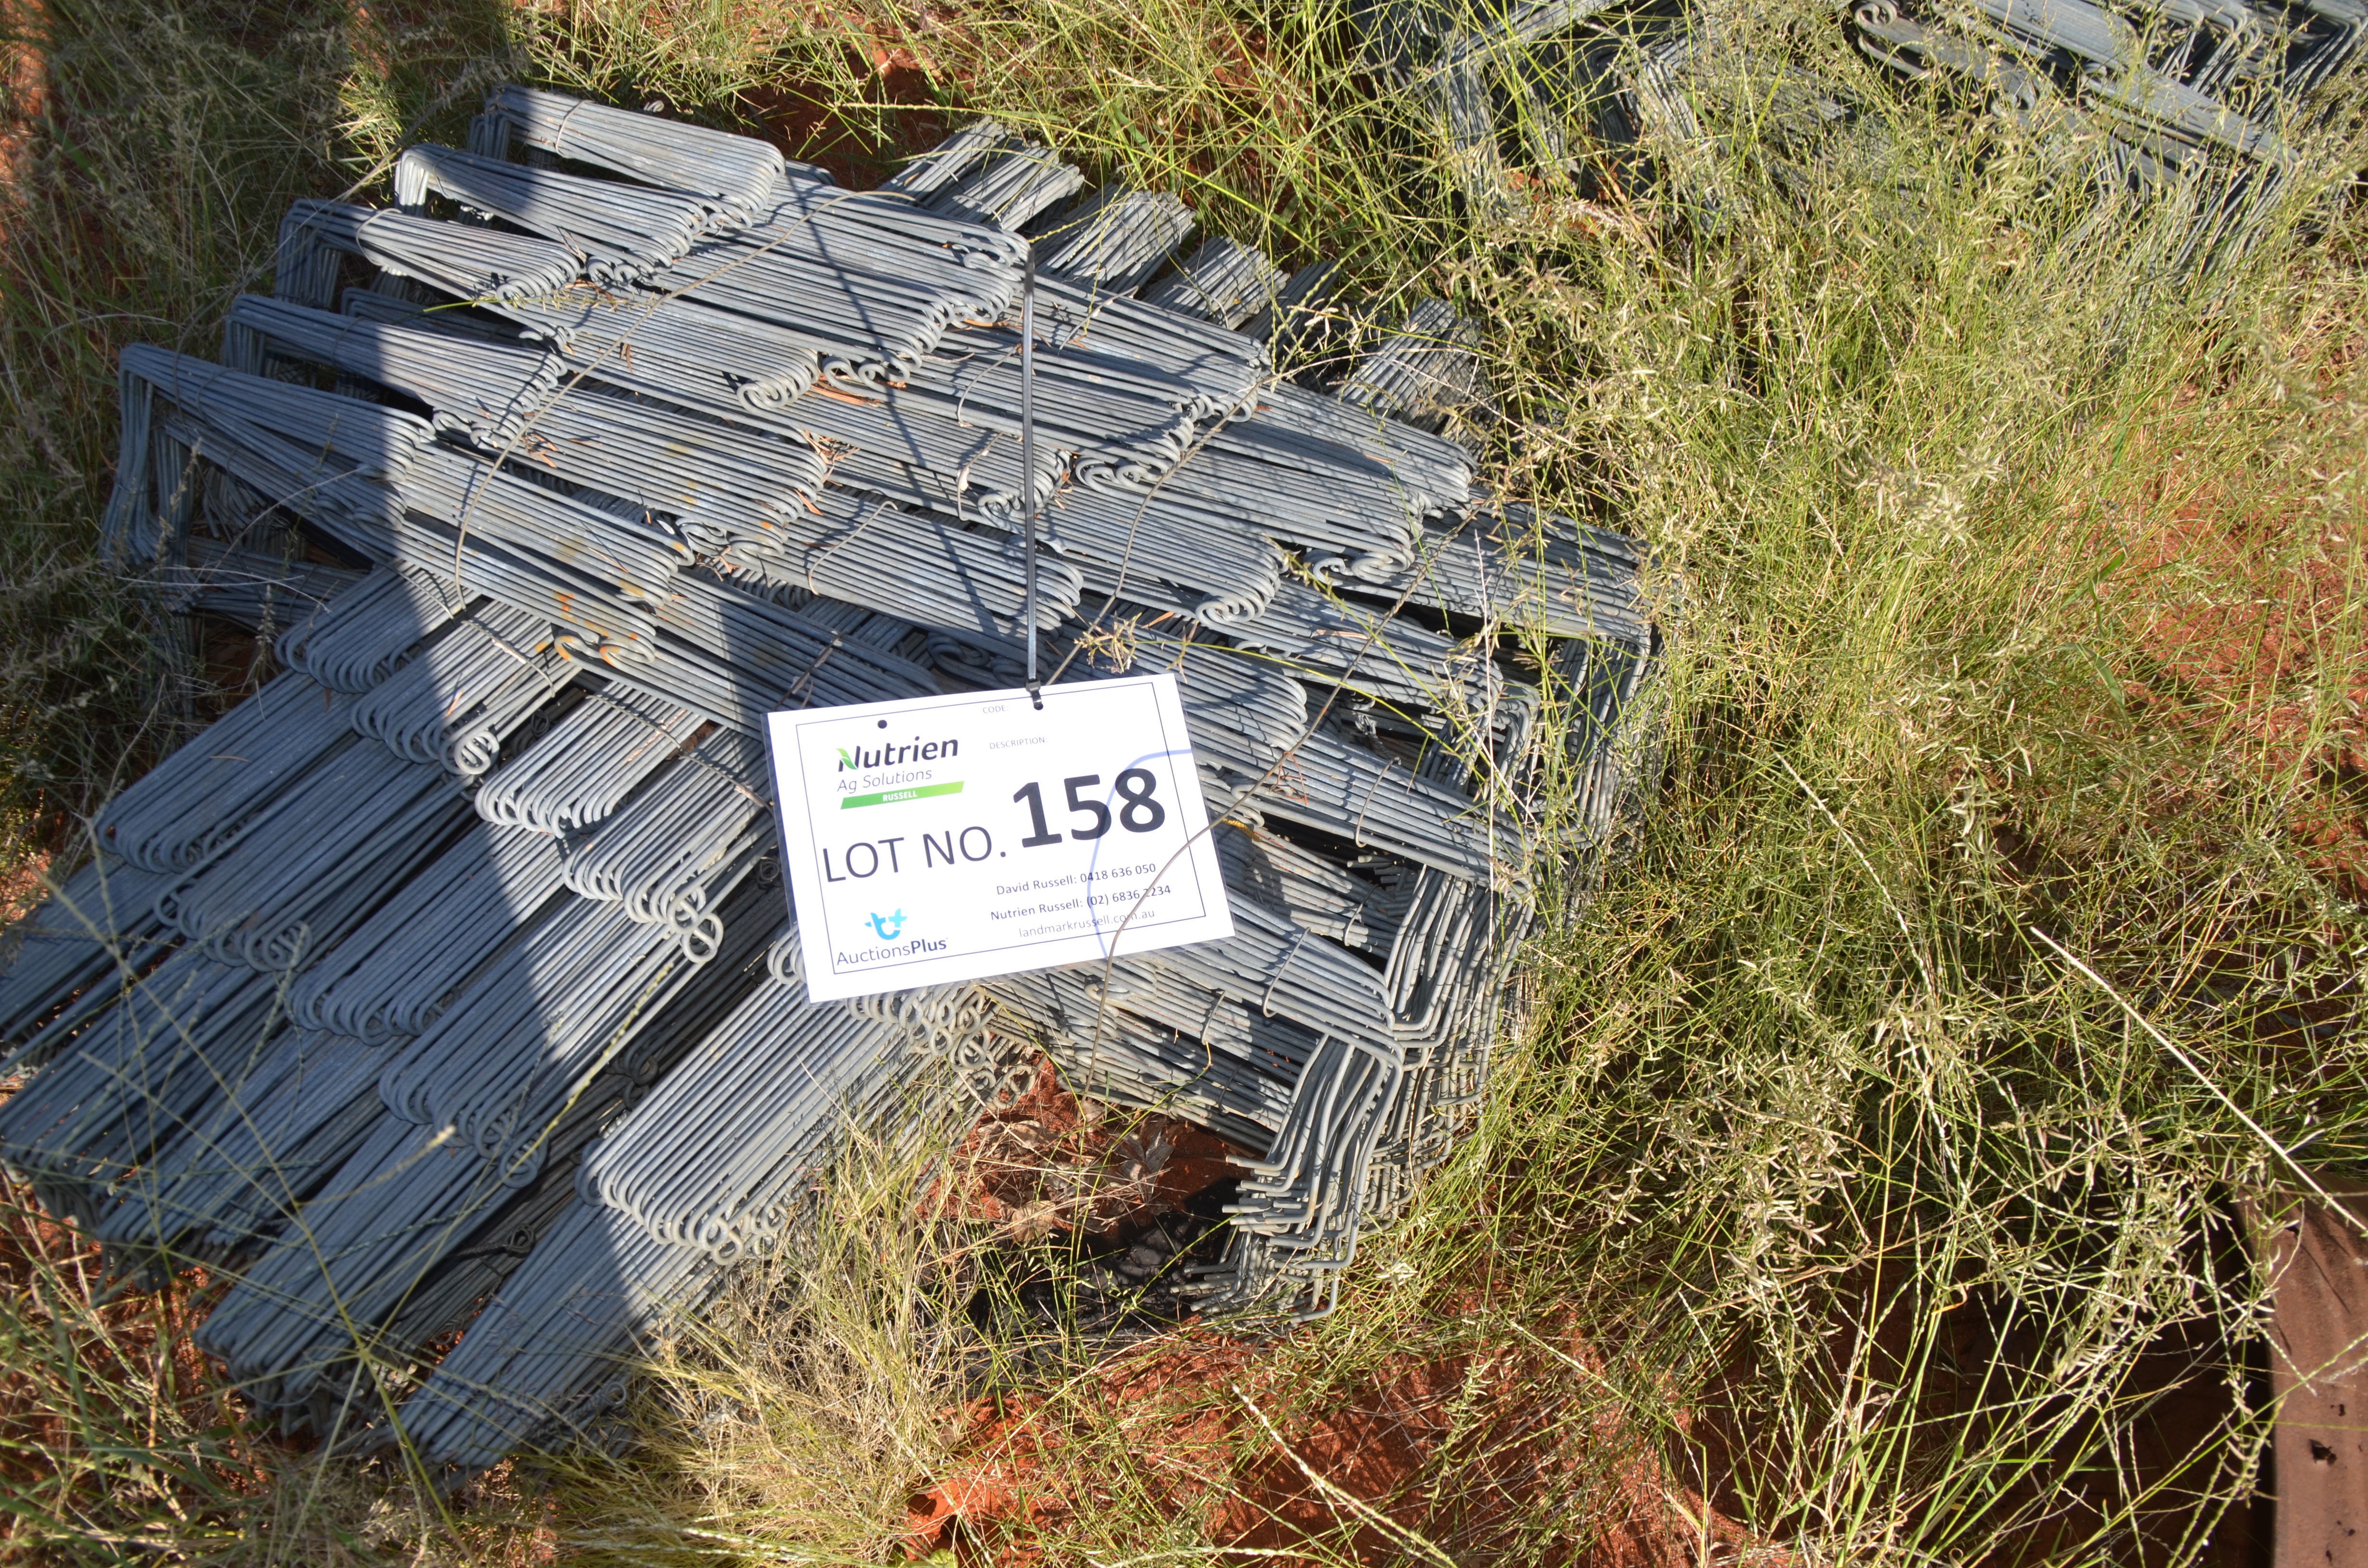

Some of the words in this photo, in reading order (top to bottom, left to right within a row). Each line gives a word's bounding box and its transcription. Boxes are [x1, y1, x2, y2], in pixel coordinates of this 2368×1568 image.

[836, 735, 959, 772] Nutrien
[837, 779, 857, 794] Ag
[862, 770, 932, 788] Solutions
[882, 790, 918, 802] RUSSELL
[822, 836, 905, 883] LOT
[922, 826, 1007, 868] NO.
[1012, 768, 1166, 848] 158
[996, 881, 1030, 895] David
[1033, 874, 1077, 890] Russell:
[1080, 870, 1109, 882] 0418
[1111, 867, 1132, 878] 636
[1135, 863, 1156, 874] 050
[990, 907, 1036, 920] Nutrien
[1039, 898, 1083, 913] Russell:
[1086, 894, 1109, 909] (02)
[1112, 890, 1140, 902] 6836
[837, 938, 947, 966] AuctionsPlus
